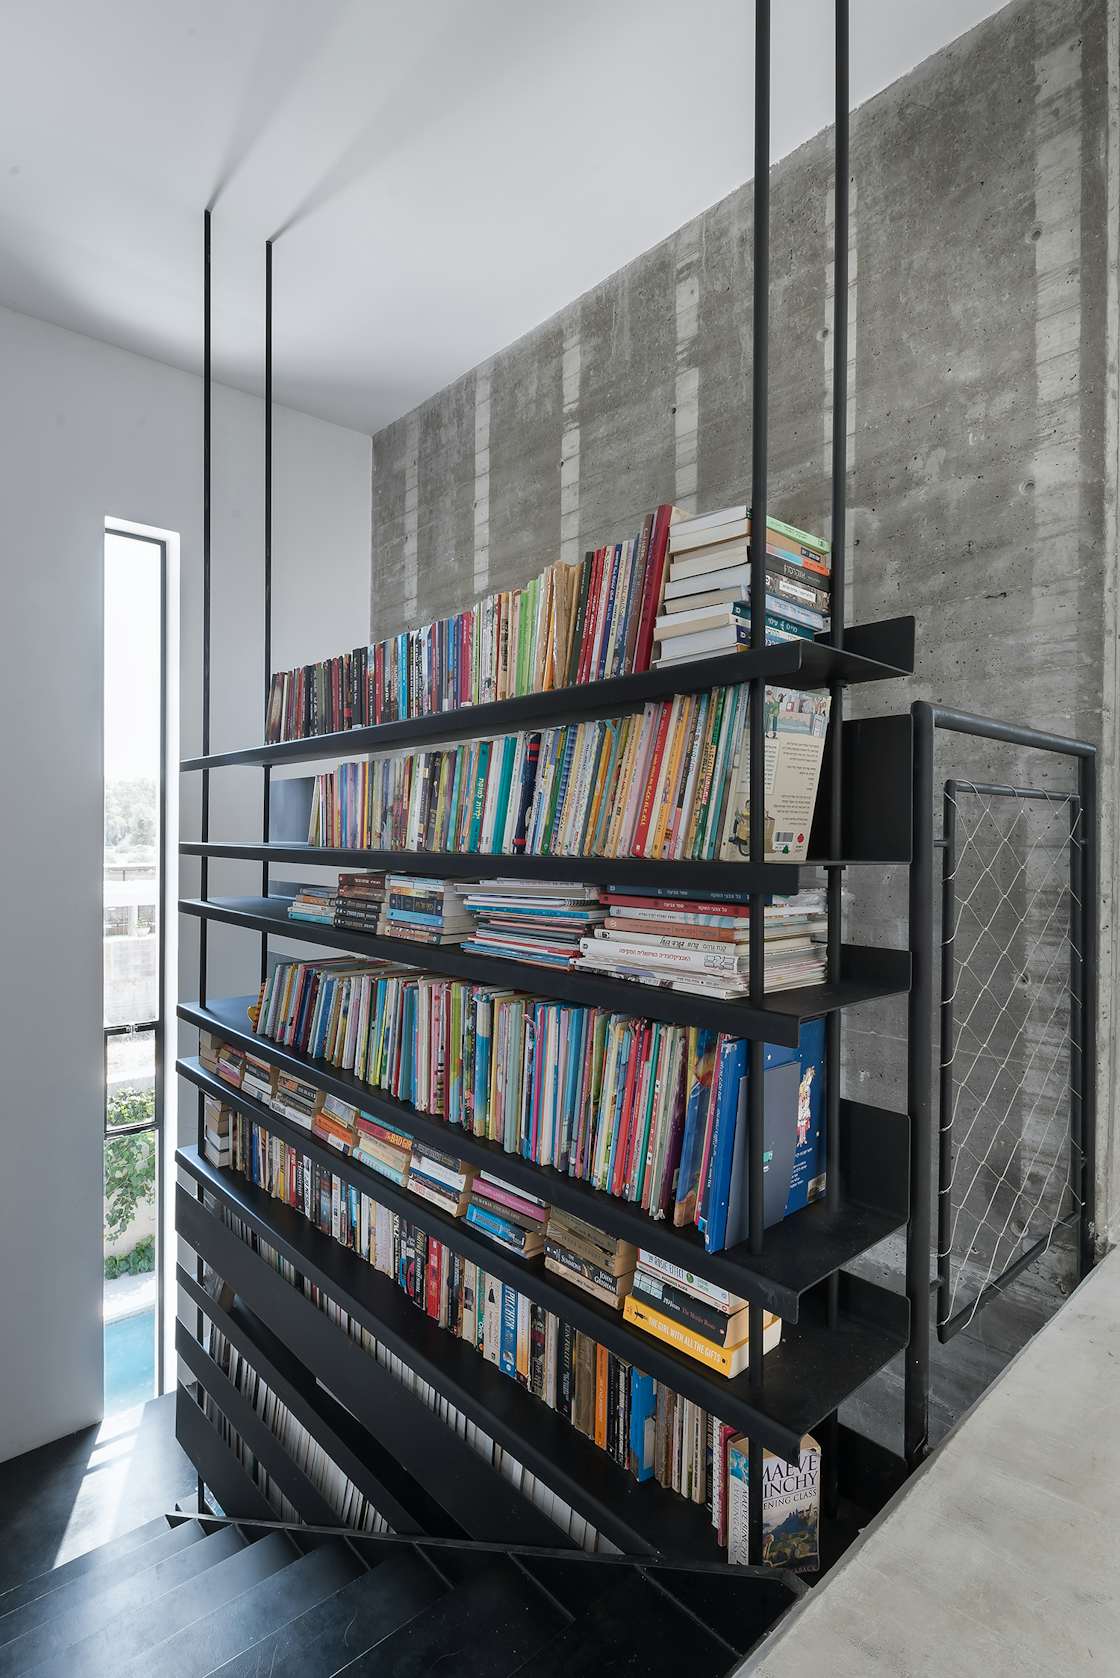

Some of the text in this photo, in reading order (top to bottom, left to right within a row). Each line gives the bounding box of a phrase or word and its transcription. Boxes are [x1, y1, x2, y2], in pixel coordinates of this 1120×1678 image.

[599, 1271, 613, 1284] JOHN
[504, 1290, 516, 1330] PILCHER
[648, 1316, 721, 1363] THE GIRL WITH ALL THE GIFTS
[764, 1470, 818, 1498] INCHY
[763, 1488, 817, 1510] ENING CLASS
